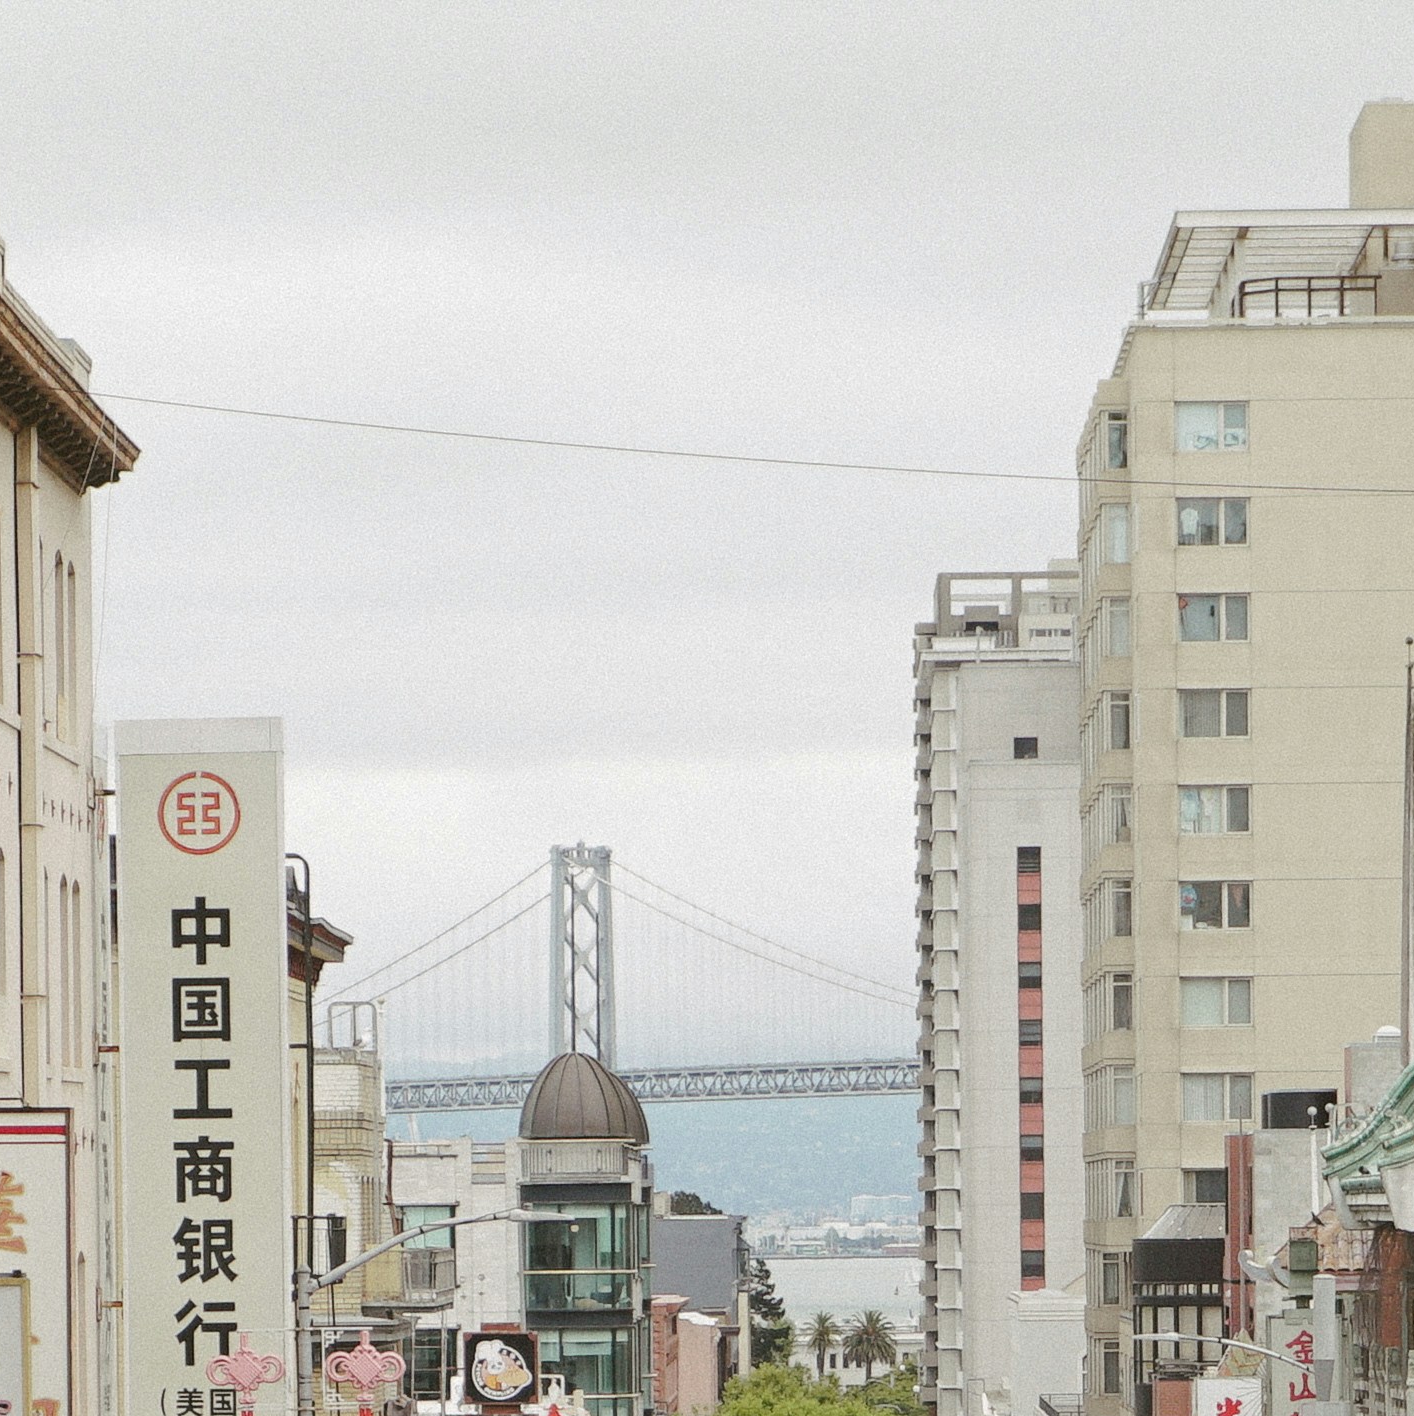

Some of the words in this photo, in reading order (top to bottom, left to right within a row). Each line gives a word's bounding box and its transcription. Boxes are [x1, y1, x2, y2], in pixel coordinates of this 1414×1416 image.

[172, 897, 237, 1367] 中国工商银行
